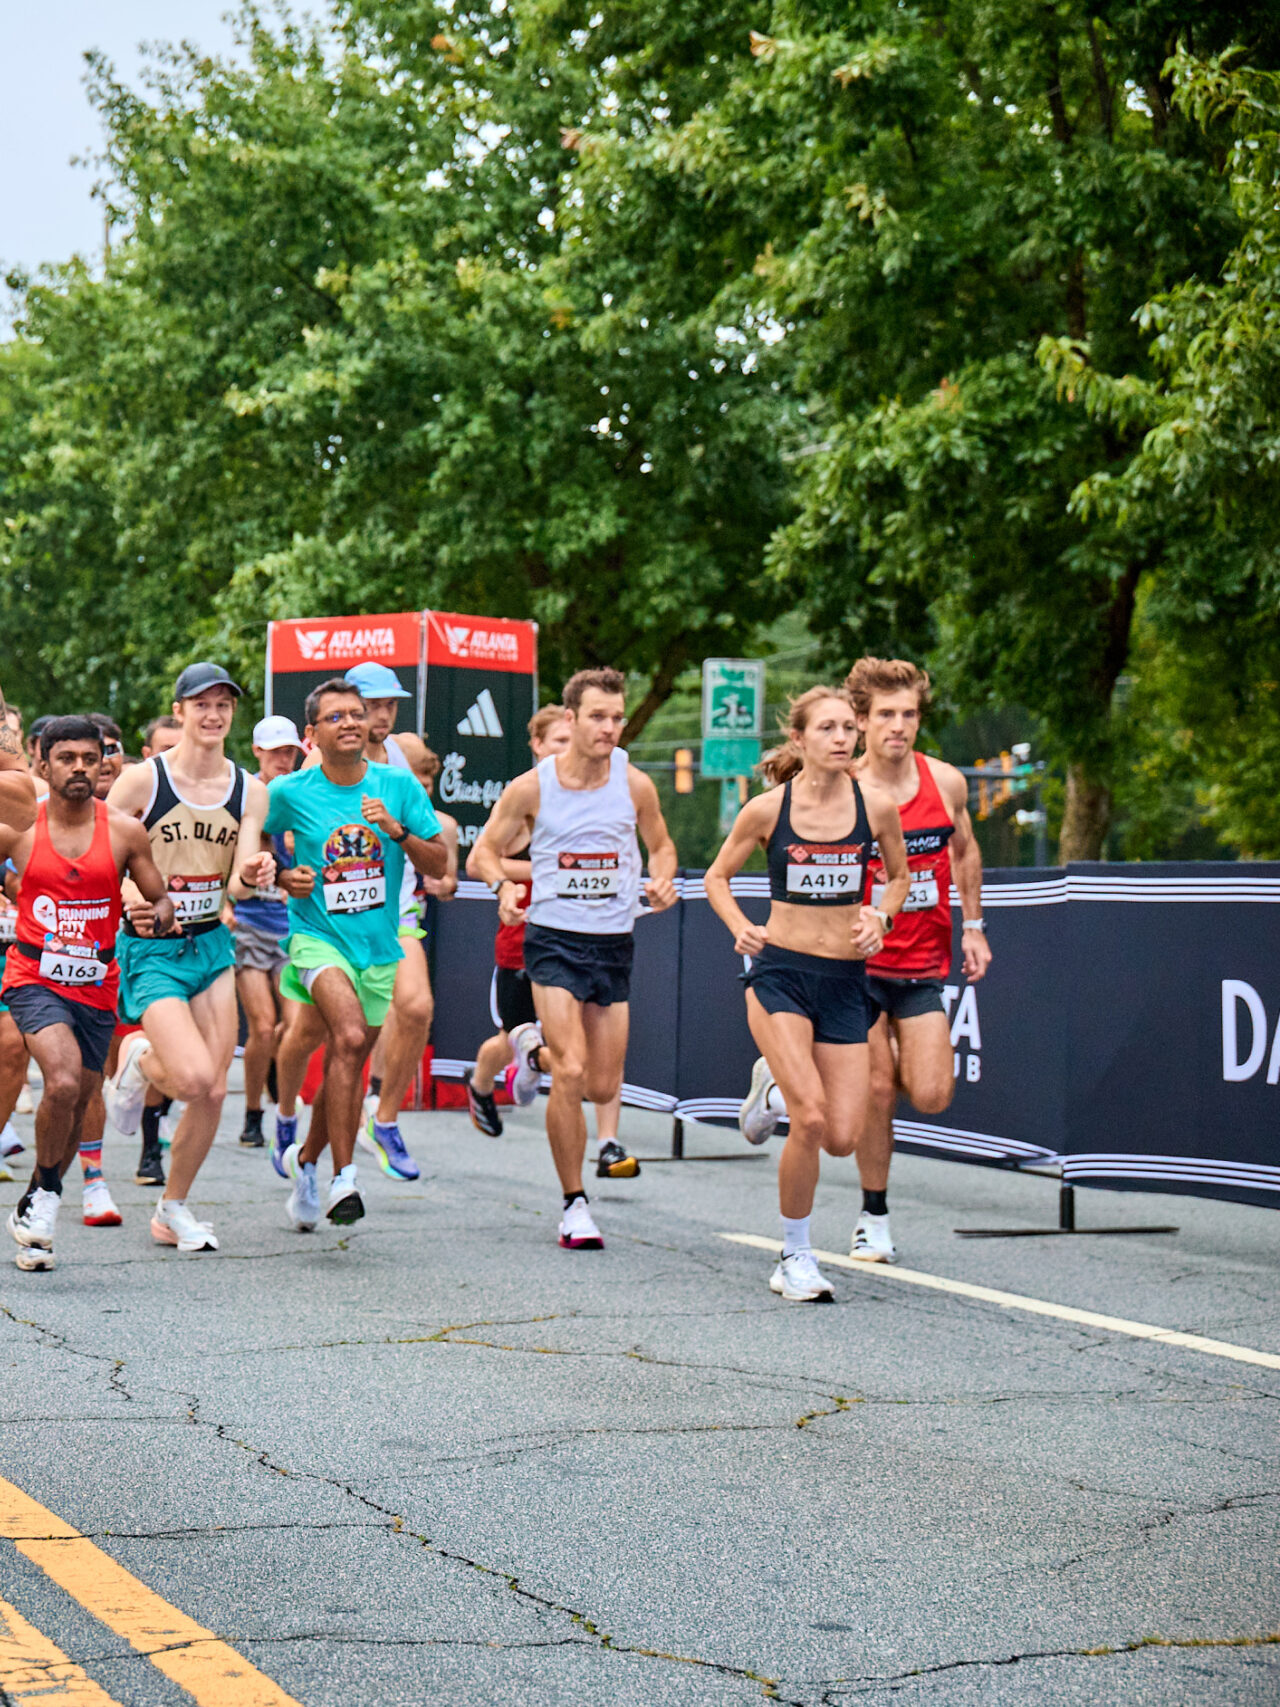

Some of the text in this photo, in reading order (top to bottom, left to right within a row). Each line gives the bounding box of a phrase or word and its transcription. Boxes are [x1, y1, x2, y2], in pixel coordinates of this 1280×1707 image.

[328, 627, 395, 649] ATLANTA
[470, 630, 518, 651] ATLANTA
[161, 822, 188, 843] ST.
[840, 853, 858, 864] 5K
[567, 876, 610, 889] A429
[800, 873, 849, 887] A419
[336, 886, 378, 904] A270
[908, 889, 928, 904] 53
[57, 906, 110, 921] RUNNING
[58, 920, 86, 932] CITY
[51, 963, 98, 978] A163
